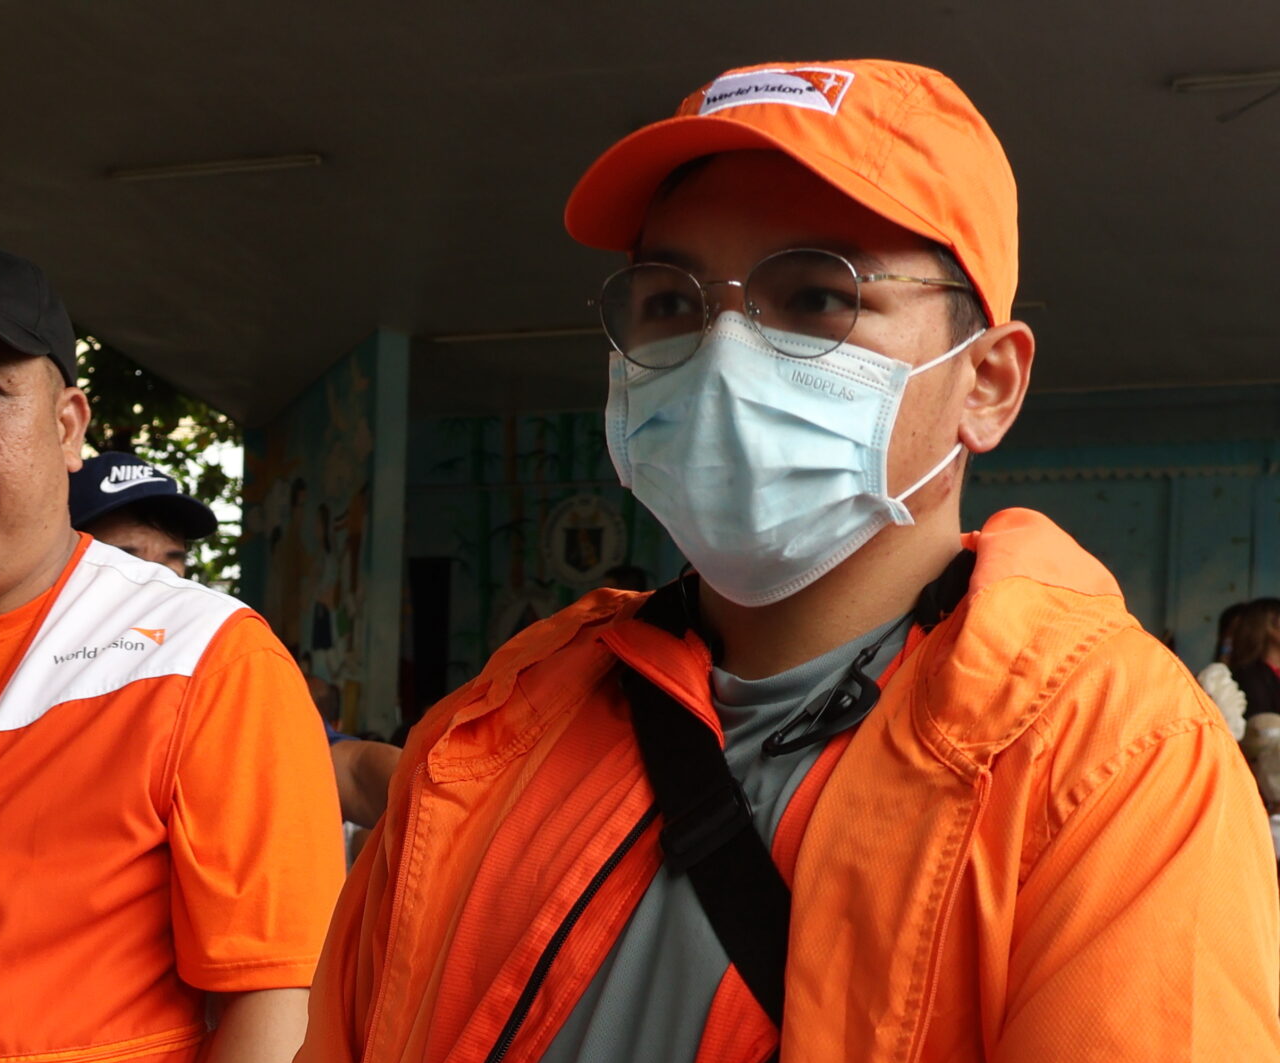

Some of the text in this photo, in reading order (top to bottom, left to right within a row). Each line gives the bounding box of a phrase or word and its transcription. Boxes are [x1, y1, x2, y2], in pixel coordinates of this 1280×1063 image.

[706, 84, 804, 105] World Vision
[791, 369, 856, 401] INDOPLAS
[110, 465, 154, 482] NIKE
[53, 637, 145, 665] World sion
